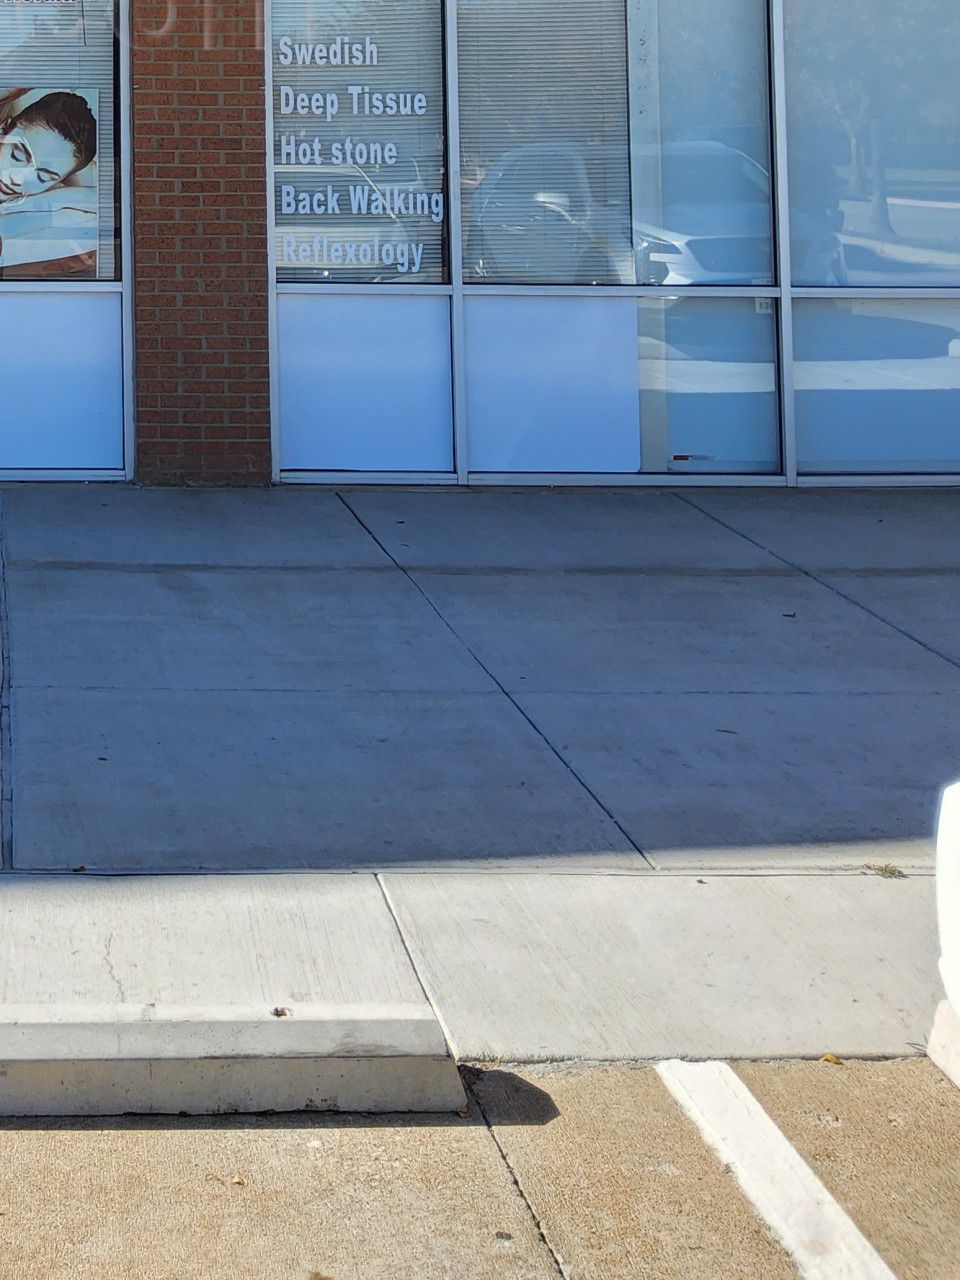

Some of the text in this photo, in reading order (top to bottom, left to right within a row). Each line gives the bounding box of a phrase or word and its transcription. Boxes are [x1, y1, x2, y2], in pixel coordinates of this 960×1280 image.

[279, 36, 379, 66] Swedish
[280, 85, 428, 122] Deep Tissue
[280, 135, 398, 165] Hot stone
[281, 185, 444, 222] Back Walking
[282, 234, 424, 273] Reflexology
